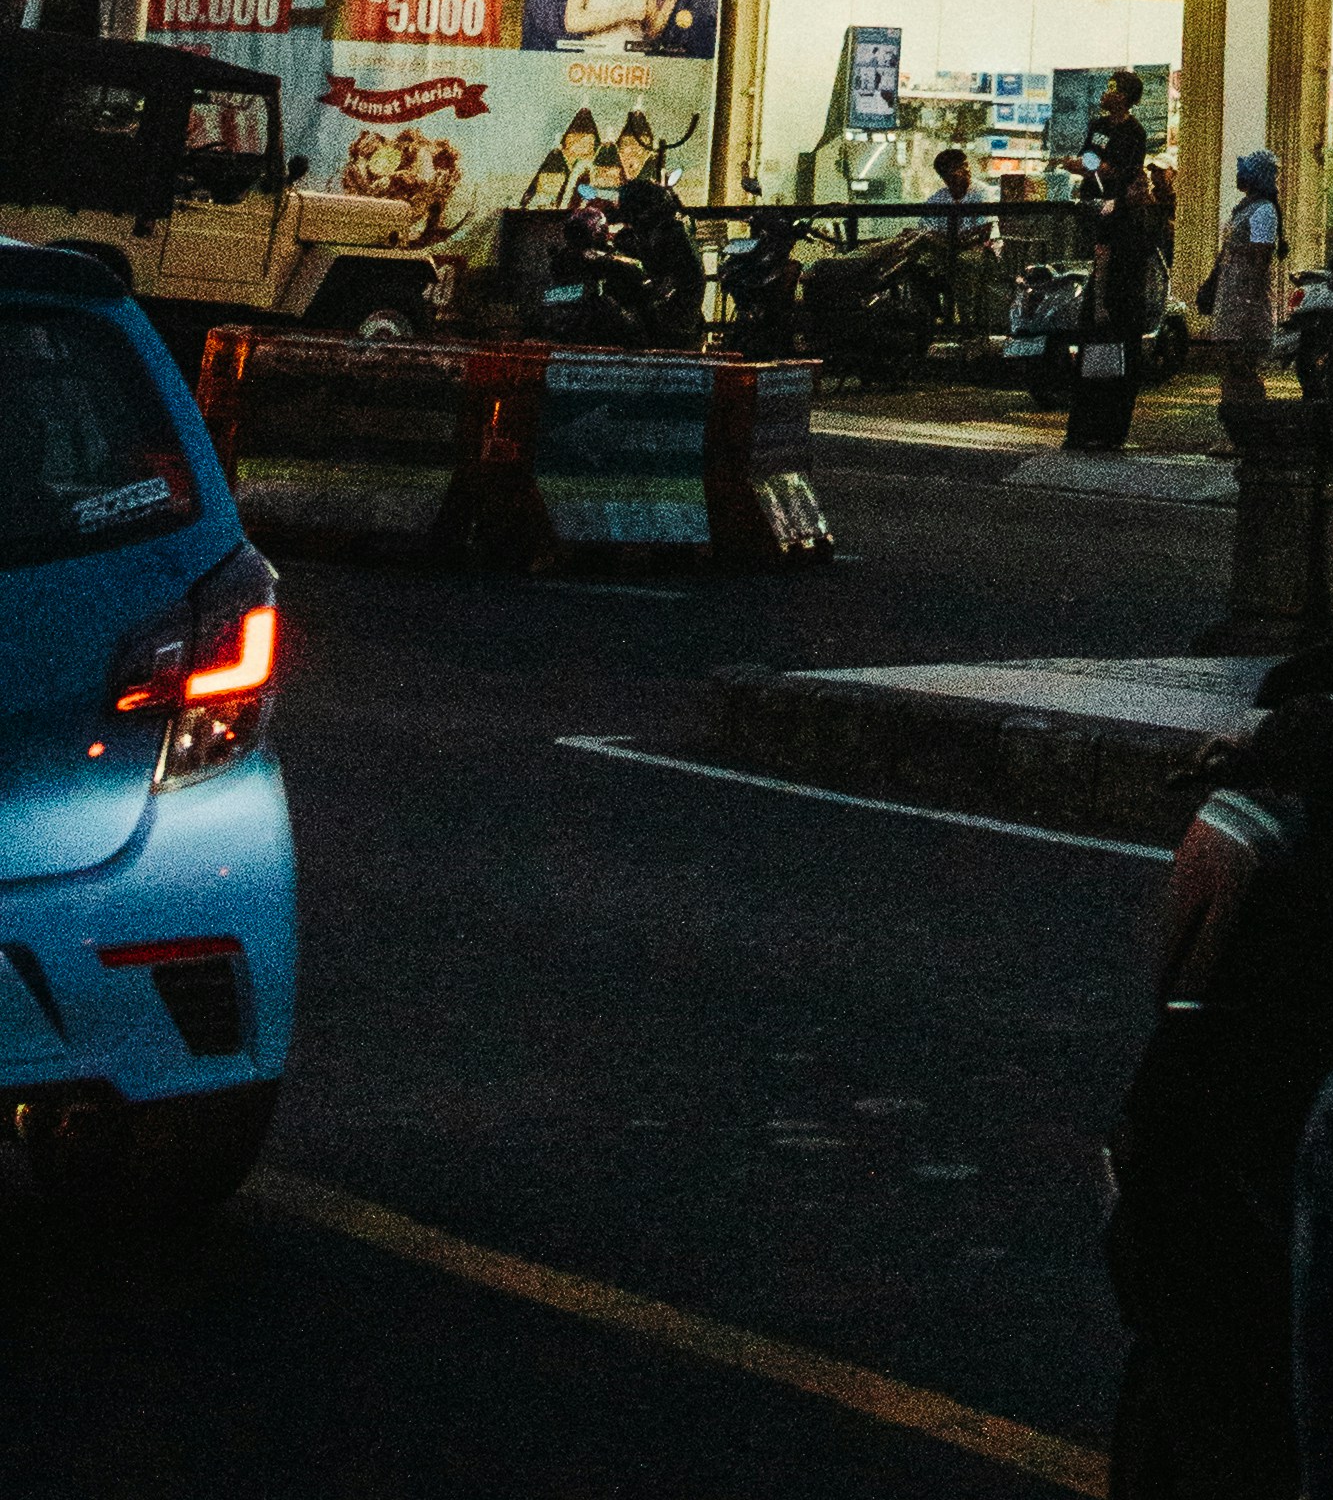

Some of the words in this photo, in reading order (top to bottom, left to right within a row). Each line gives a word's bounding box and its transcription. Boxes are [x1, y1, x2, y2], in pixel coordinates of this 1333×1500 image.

[567, 61, 652, 90] ONIGIRI
[343, 92, 402, 117] Hemat
[403, 81, 465, 109] Meriah
